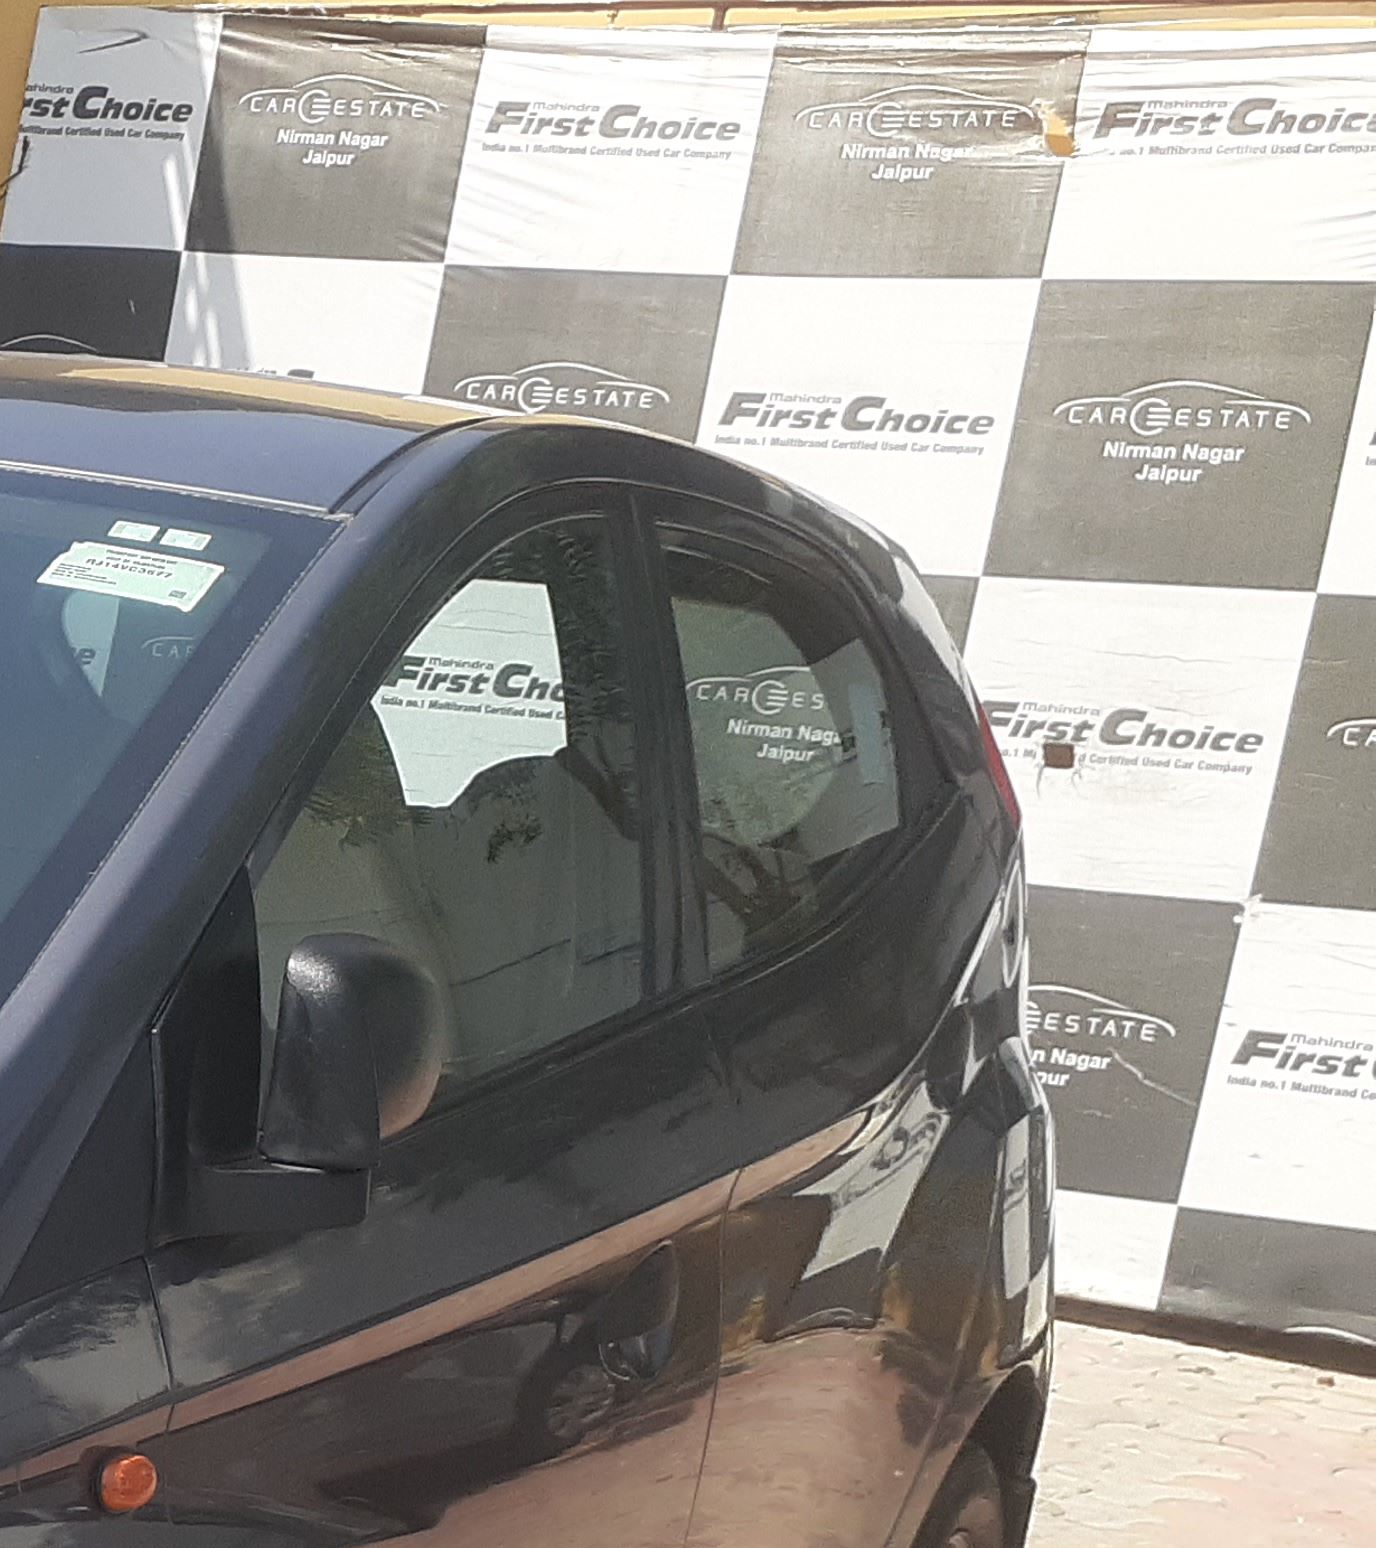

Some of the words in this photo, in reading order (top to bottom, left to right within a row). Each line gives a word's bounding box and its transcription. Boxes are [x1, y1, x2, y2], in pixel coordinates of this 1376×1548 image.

[26, 83, 74, 94] ahindra
[24, 97, 70, 118] rst
[72, 86, 193, 122] Choice
[533, 102, 600, 112] Mahindra
[485, 101, 595, 137] First
[599, 104, 741, 140] Choice
[1093, 101, 1223, 139] First
[277, 128, 335, 146] Nirman
[338, 131, 389, 150] Nagar
[1328, 143, 1376, 155] Compan
[302, 149, 355, 168] Jaipur
[636, 147, 661, 157] Used
[663, 148, 680, 158] Car
[684, 149, 732, 161] Company
[841, 143, 910, 159] Nirman
[872, 163, 934, 183] Jaipur
[769, 392, 842, 404] Mahindra
[718, 391, 837, 430] First
[841, 396, 995, 435] Choice
[770, 437, 828, 449] Multibrand
[831, 439, 878, 450] Certified
[881, 440, 907, 451] Used
[911, 441, 929, 452] Car
[933, 443, 984, 455] Company
[1103, 441, 1177, 460] Nirman
[1182, 442, 1245, 464] Nagar
[1135, 464, 1203, 485] Jaipur
[429, 657, 494, 670] Mahindra
[383, 655, 491, 694] First
[1022, 702, 1100, 715] Mahindra
[727, 718, 793, 739] Nirman
[981, 700, 1095, 742] First
[1099, 708, 1263, 753] Choice
[757, 743, 815, 764] Jaipur
[1089, 754, 1138, 766] Certified
[1142, 757, 1170, 768] Used
[1174, 758, 1194, 770] Car
[1198, 760, 1252, 775] Company
[1290, 1033, 1373, 1051] Mahindra
[1050, 1048, 1112, 1071] Nagar
[1230, 1029, 1368, 1078] First
[1227, 1075, 1257, 1087] India
[1260, 1080, 1286, 1090] no.1
[1290, 1081, 1358, 1098] Multibrand
